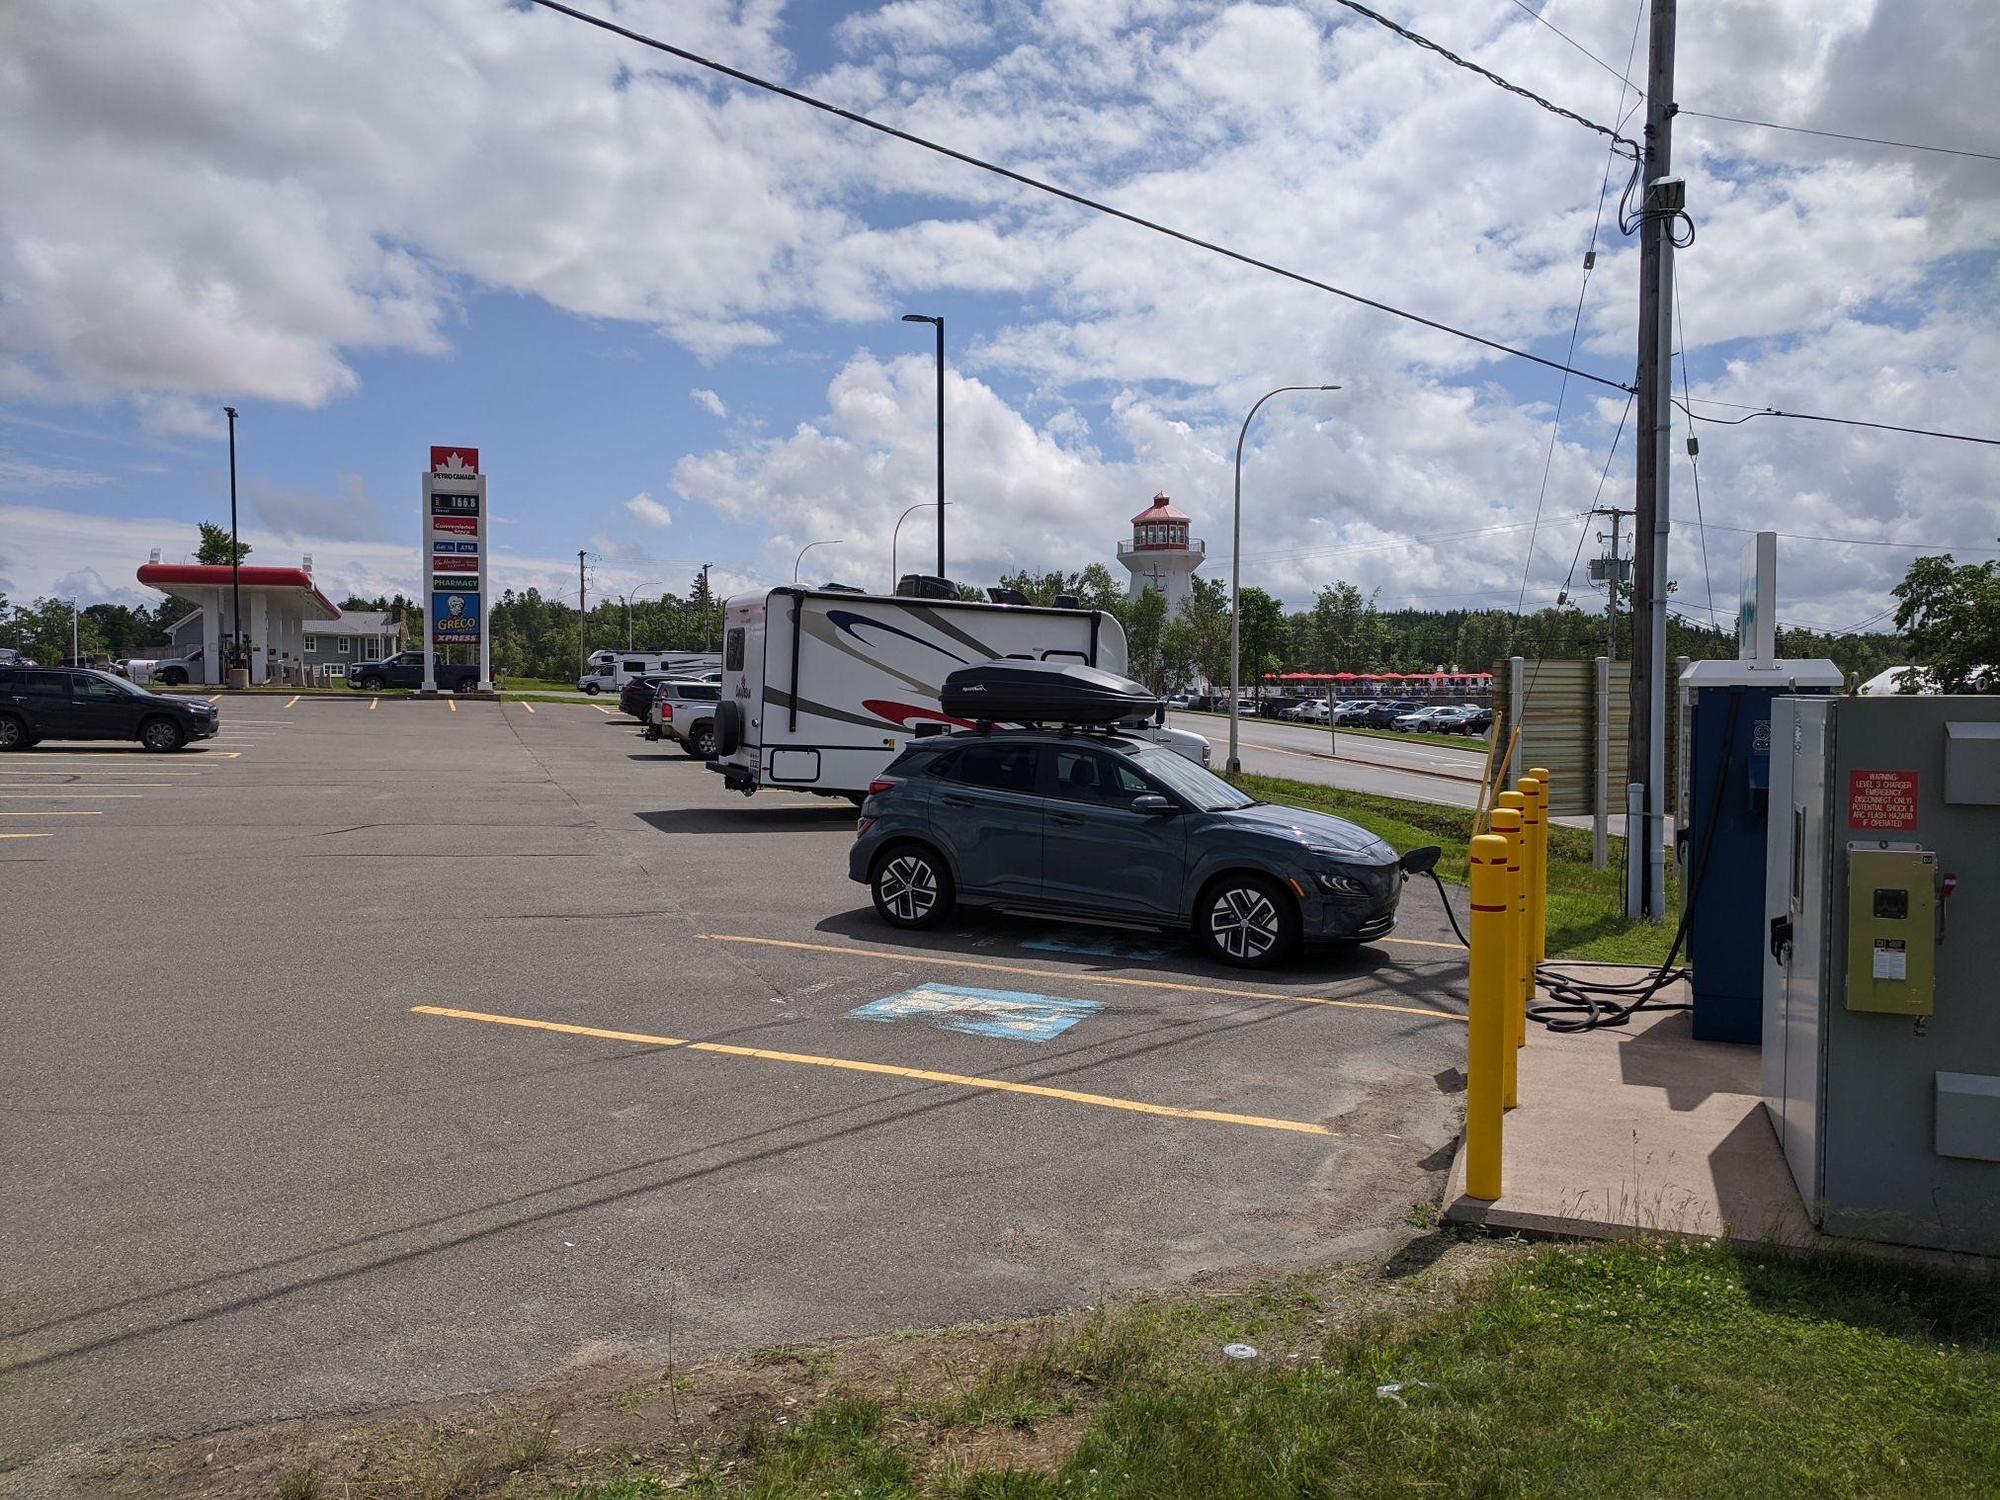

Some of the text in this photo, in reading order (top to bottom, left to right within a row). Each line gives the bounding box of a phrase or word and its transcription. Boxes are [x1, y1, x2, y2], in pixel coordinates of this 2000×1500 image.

[434, 579, 478, 587] PHARMACY
[438, 618, 476, 630] GRECO
[1856, 780, 1873, 788] LEVEL
[1883, 781, 1912, 789] CHARGER
[1854, 796, 1891, 804] DISCONNECT
[1852, 803, 1883, 811] POTENTIAL
[1887, 804, 1907, 812] SHOCK
[1867, 811, 1887, 819] FLASH
[1889, 812, 1913, 820] HAZARD
[1871, 819, 1902, 827] OPERATED
